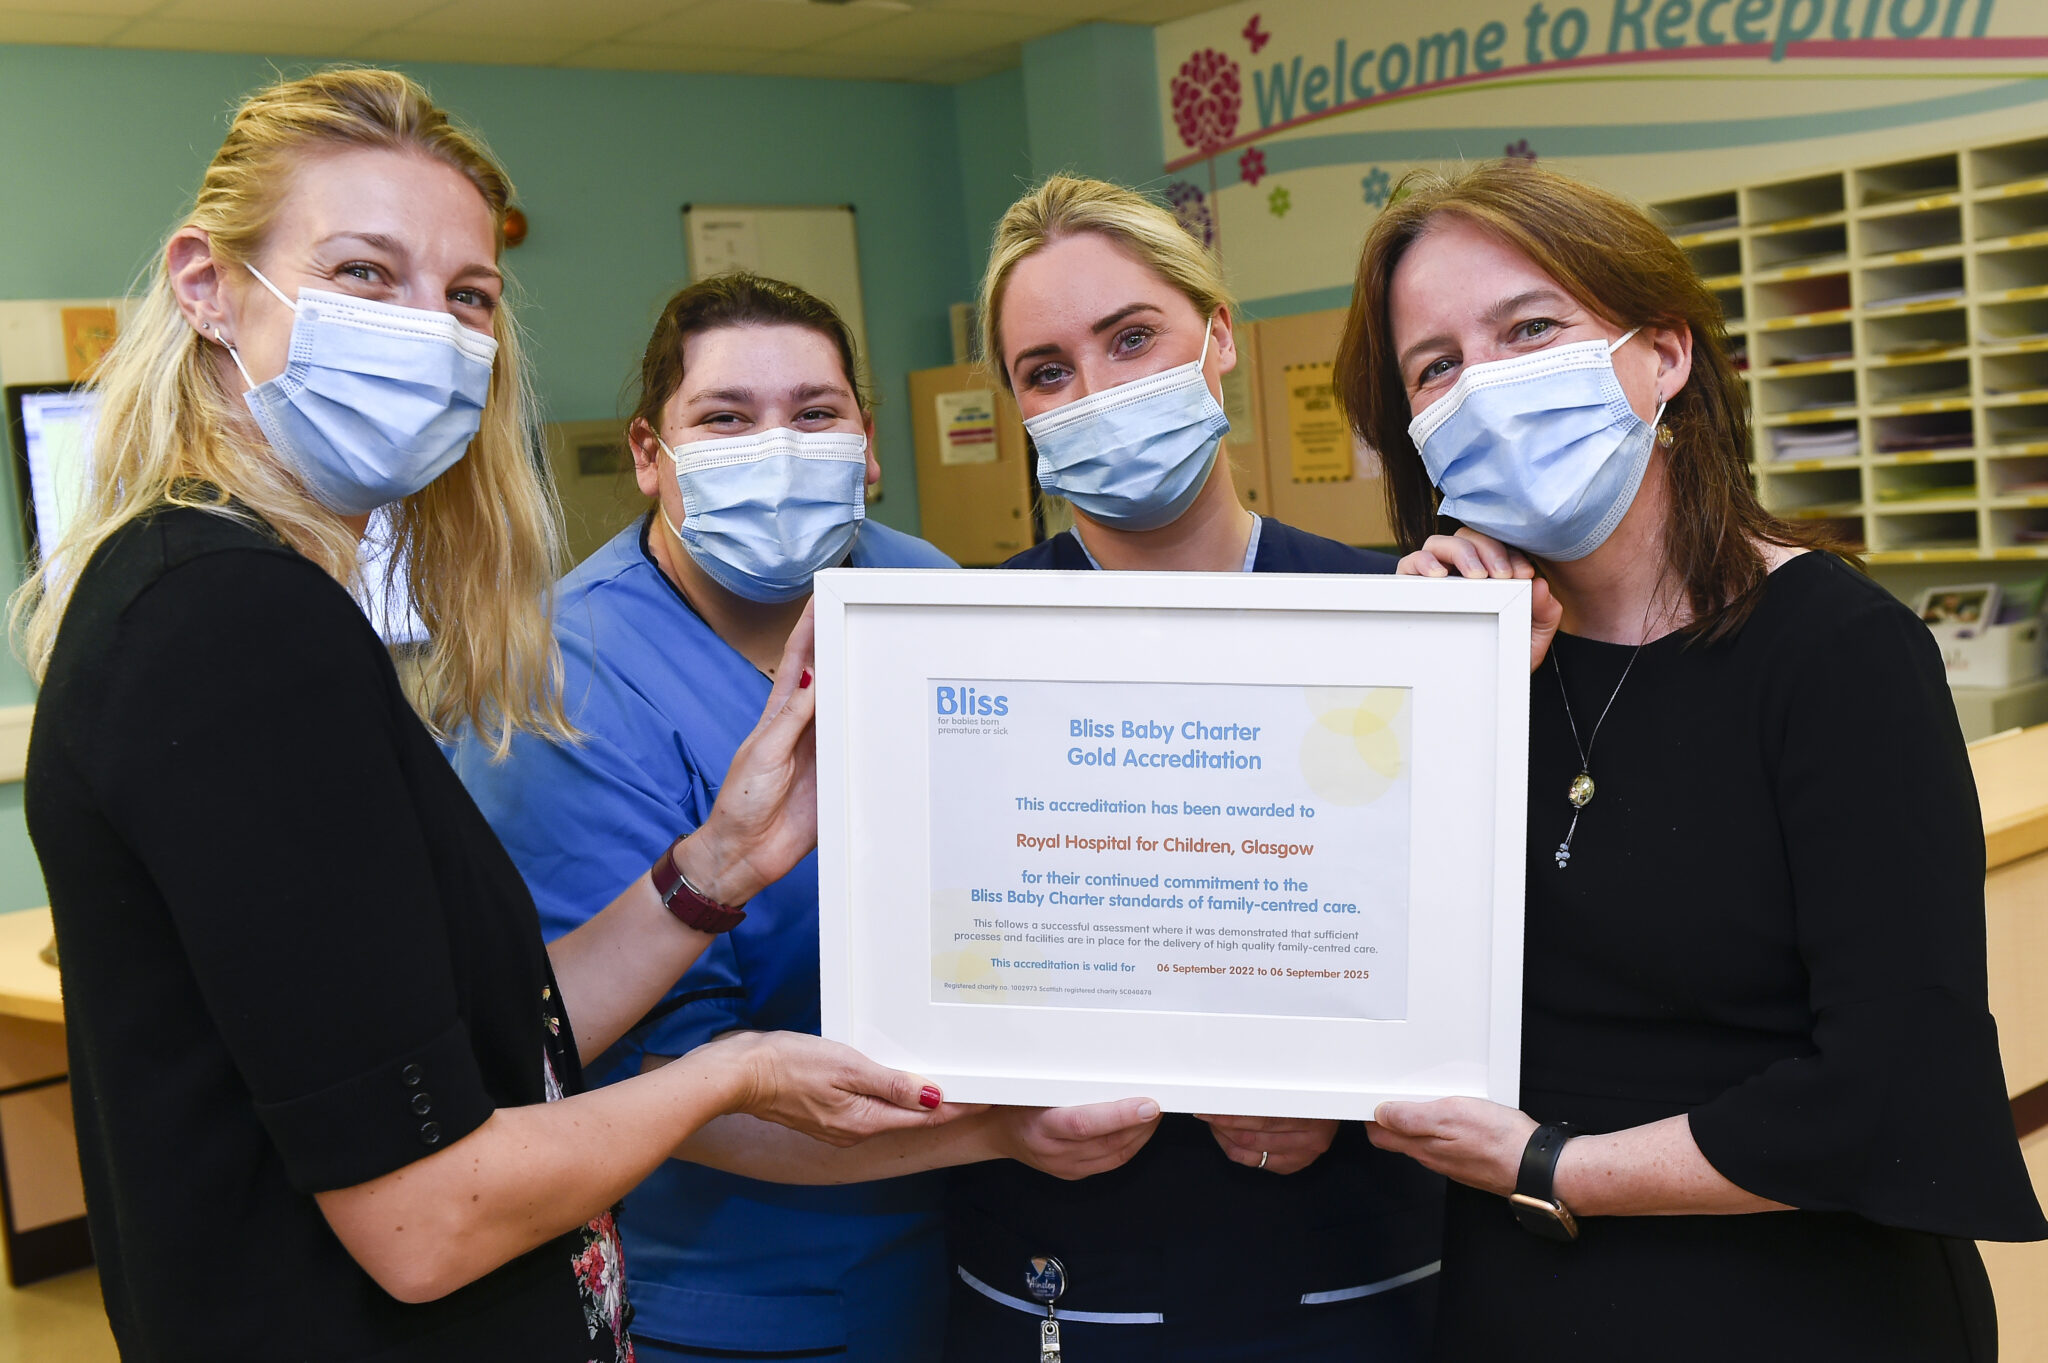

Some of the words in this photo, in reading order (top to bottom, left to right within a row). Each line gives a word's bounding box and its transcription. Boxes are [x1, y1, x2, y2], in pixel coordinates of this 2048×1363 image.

[1253, 20, 1507, 129] Welcome
[1525, 1, 1588, 65] to
[936, 686, 1009, 716] Bliss
[937, 716, 949, 725] for
[952, 717, 978, 725] babies
[980, 718, 1000, 726] born
[938, 727, 981, 736] premature
[993, 727, 1008, 735] sick
[1070, 718, 1115, 738] Bliss
[1122, 720, 1175, 744] Baby
[1181, 720, 1261, 741] Charter
[1067, 747, 1116, 767] Gold
[1122, 748, 1262, 770] Accreditation
[1015, 796, 1045, 811] This
[1049, 798, 1146, 814] accreditation
[1152, 800, 1178, 815] has
[1183, 801, 1221, 816] been
[1226, 802, 1295, 818] awarded
[1299, 805, 1315, 818] to
[1016, 833, 1060, 852] Royal
[1065, 834, 1131, 854] Hospital
[1136, 836, 1159, 852] for
[1163, 837, 1235, 856] Children,
[1241, 839, 1314, 859] Glasgow
[1021, 870, 1043, 884] for
[1046, 870, 1081, 885] their
[1084, 873, 1159, 888] continued
[1164, 876, 1260, 890] commitment
[1263, 878, 1279, 891] to
[1283, 878, 1308, 892] the
[971, 888, 1003, 903] Bliss
[1007, 890, 1045, 908] Baby
[1049, 891, 1105, 906] Charter
[1109, 894, 1184, 909] standards
[1188, 895, 1204, 909] of
[1207, 896, 1318, 914] family-centred
[1323, 902, 1361, 914] care.
[973, 918, 992, 928] This
[994, 919, 1029, 929] follows
[1032, 922, 1038, 930] a
[1040, 922, 1090, 931] successful
[1092, 924, 1150, 934] assessment
[1152, 925, 1184, 935] where
[1186, 926, 1192, 935] it
[1195, 928, 1216, 936] was
[1218, 927, 1288, 938] demonstrated
[1290, 929, 1311, 938] that
[1314, 930, 1359, 940] sufficient
[954, 933, 1001, 942] processes
[1004, 933, 1023, 942] and
[1025, 933, 1064, 944] facilities
[1086, 936, 1095, 944] in
[1098, 936, 1125, 947] place
[1127, 937, 1142, 946] for
[1144, 937, 1160, 947] the
[1162, 938, 1201, 950] delivery
[1204, 940, 1214, 949] of
[1216, 940, 1238, 952] high
[1241, 941, 1275, 953] quality
[1278, 942, 1351, 954] family-centred
[1354, 946, 1378, 954] care.
[990, 958, 1011, 968] This
[1013, 960, 1080, 970] accreditation
[1082, 961, 1090, 971] is
[1093, 962, 1118, 972] valid
[1120, 962, 1136, 972] for
[1156, 963, 1170, 972] 06
[1172, 964, 1227, 975] September
[1229, 966, 1254, 976] 2022
[1257, 967, 1268, 976] to
[1270, 967, 1283, 976] 06
[1286, 968, 1341, 980] September
[1344, 970, 1369, 980] 2025
